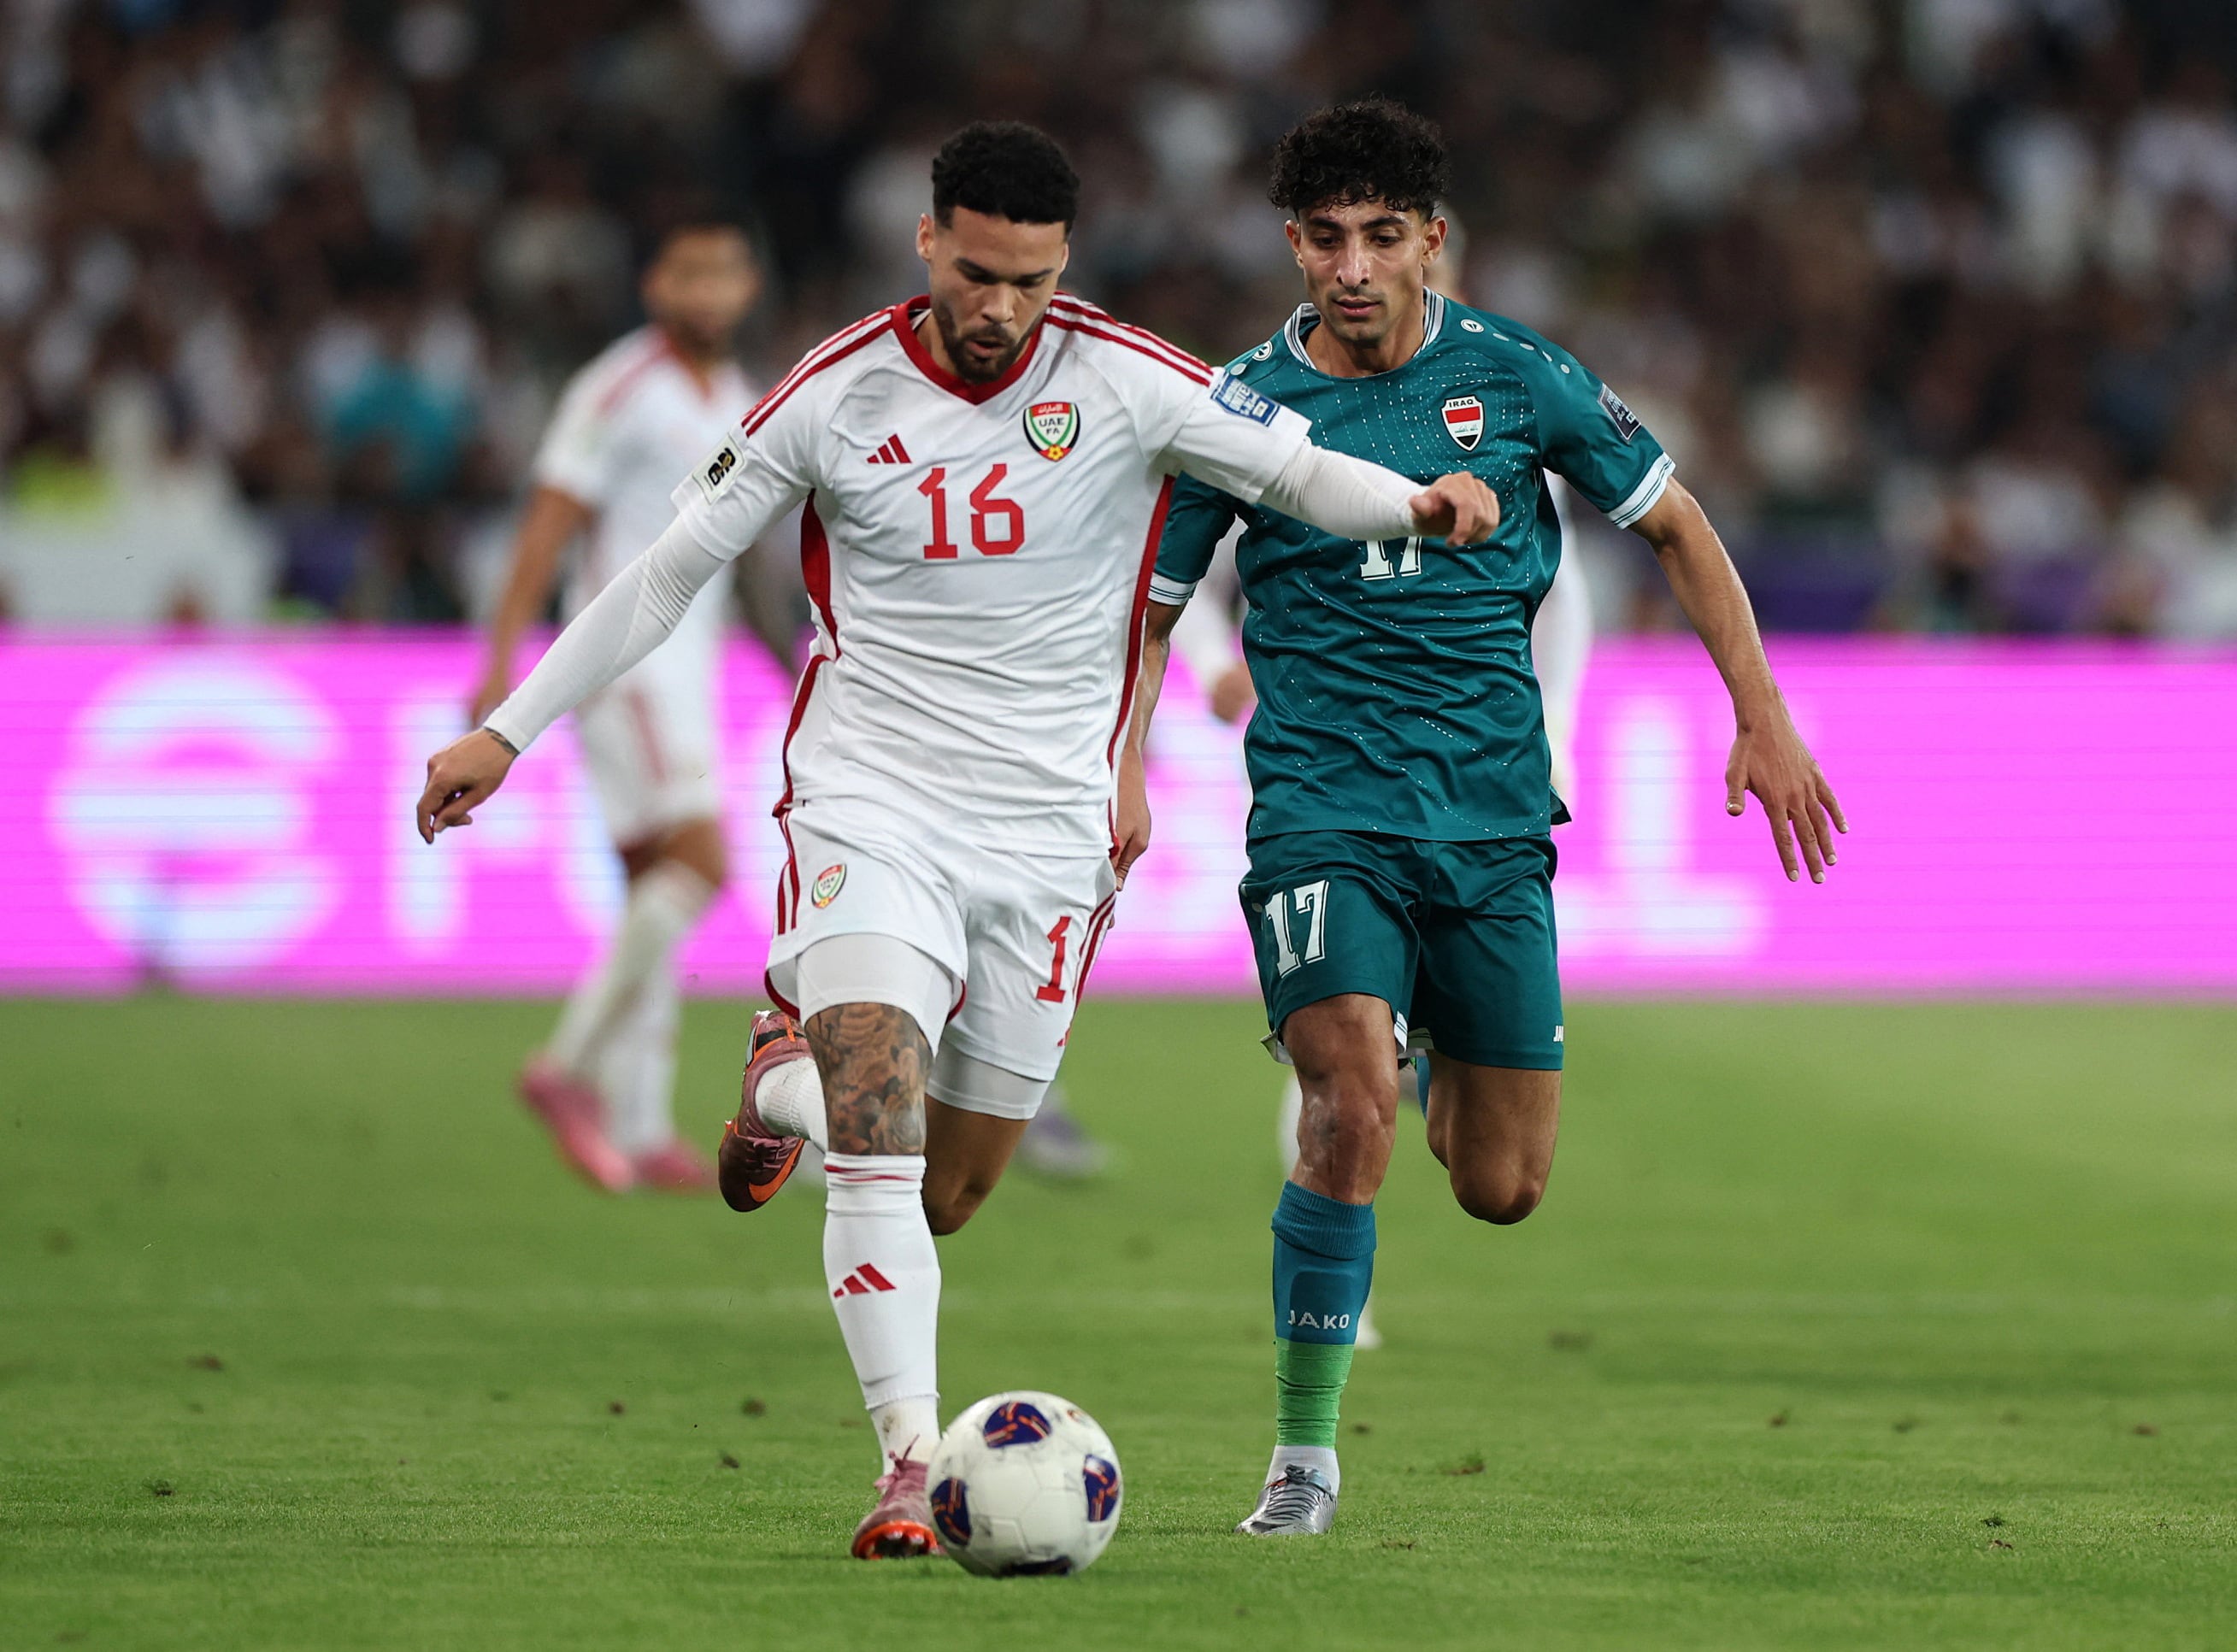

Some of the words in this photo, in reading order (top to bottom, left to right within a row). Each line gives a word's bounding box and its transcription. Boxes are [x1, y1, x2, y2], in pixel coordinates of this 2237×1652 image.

[1449, 398, 1474, 408] IRAQ
[1039, 417, 1064, 426] UAE
[917, 463, 1025, 559] 16
[1265, 879, 1329, 979] 17
[1287, 1309, 1350, 1330] JAKO
